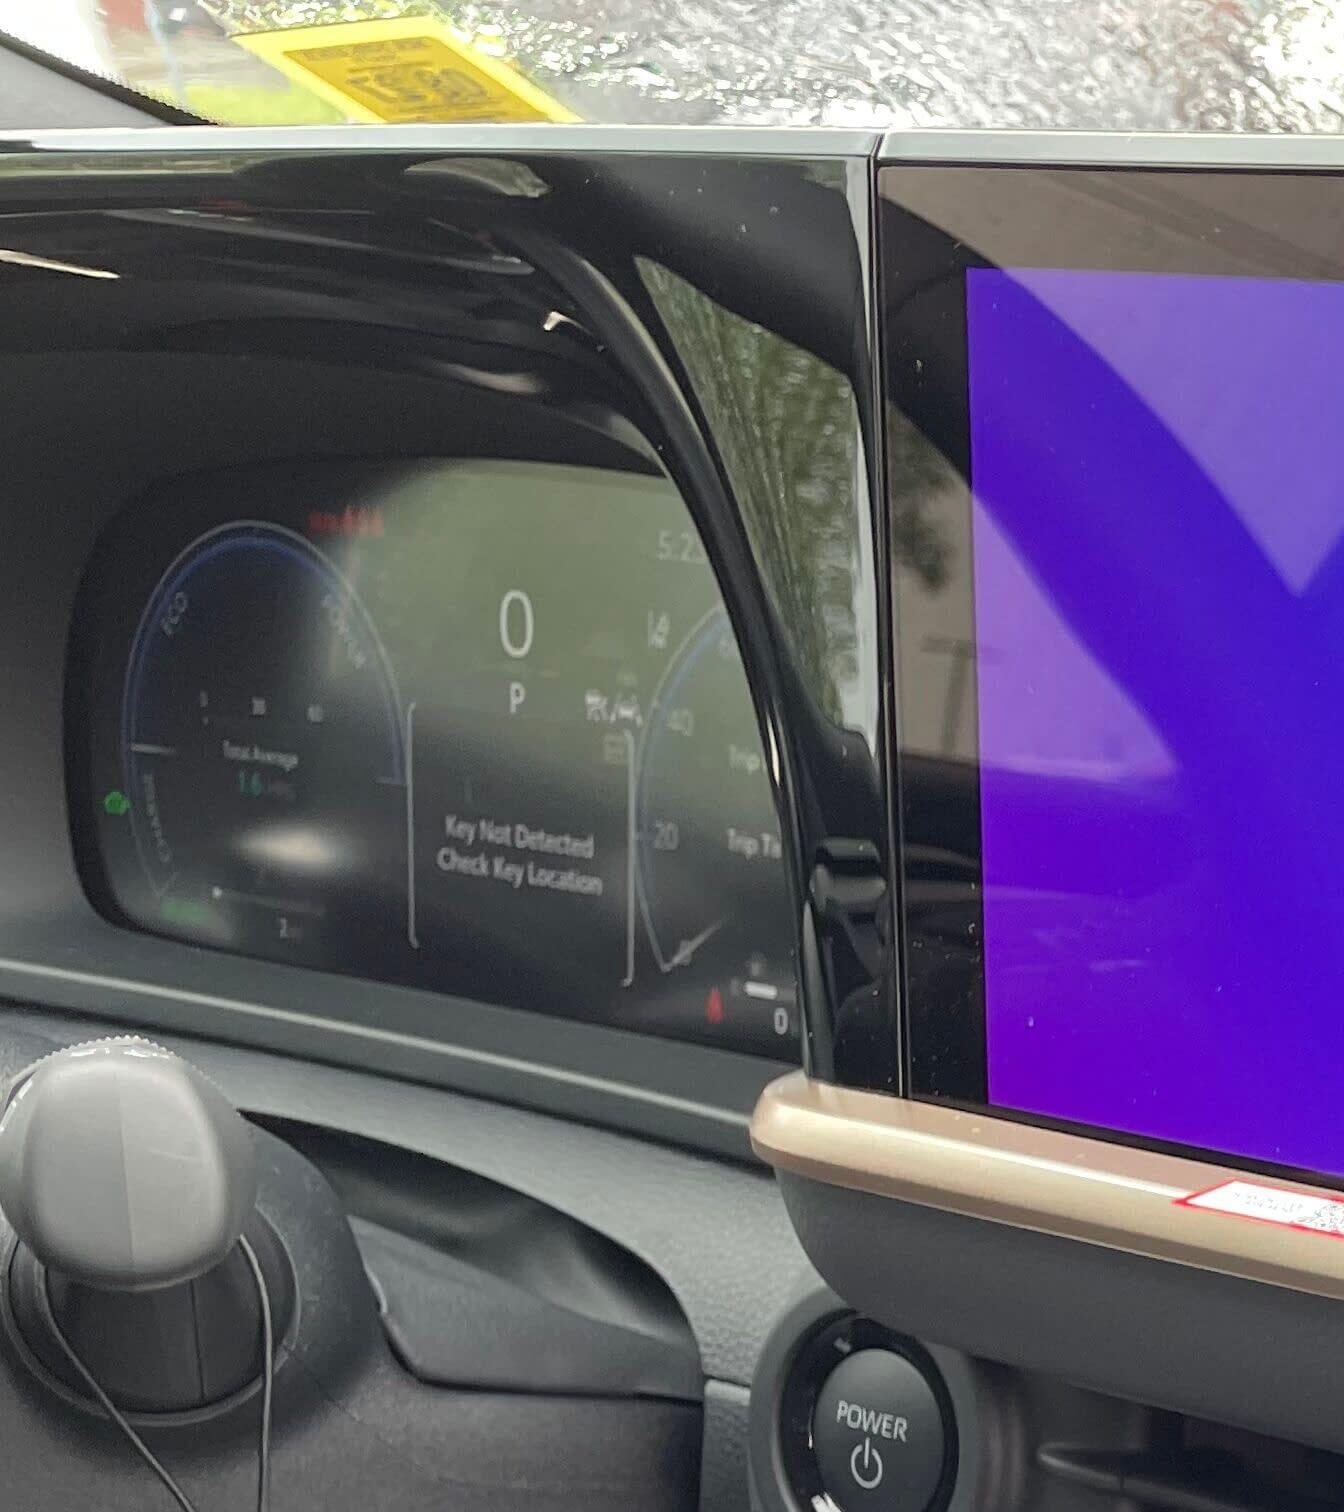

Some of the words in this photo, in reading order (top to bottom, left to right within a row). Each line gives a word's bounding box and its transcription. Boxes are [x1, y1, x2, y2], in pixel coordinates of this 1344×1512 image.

[500, 590, 534, 658] 0
[510, 681, 526, 715] P
[445, 814, 476, 847] Key
[479, 819, 512, 847] Not
[514, 824, 595, 860] Detected
[436, 847, 489, 877] Check
[493, 856, 525, 889] Key
[527, 861, 604, 896] Location
[837, 1400, 908, 1442] POWER
